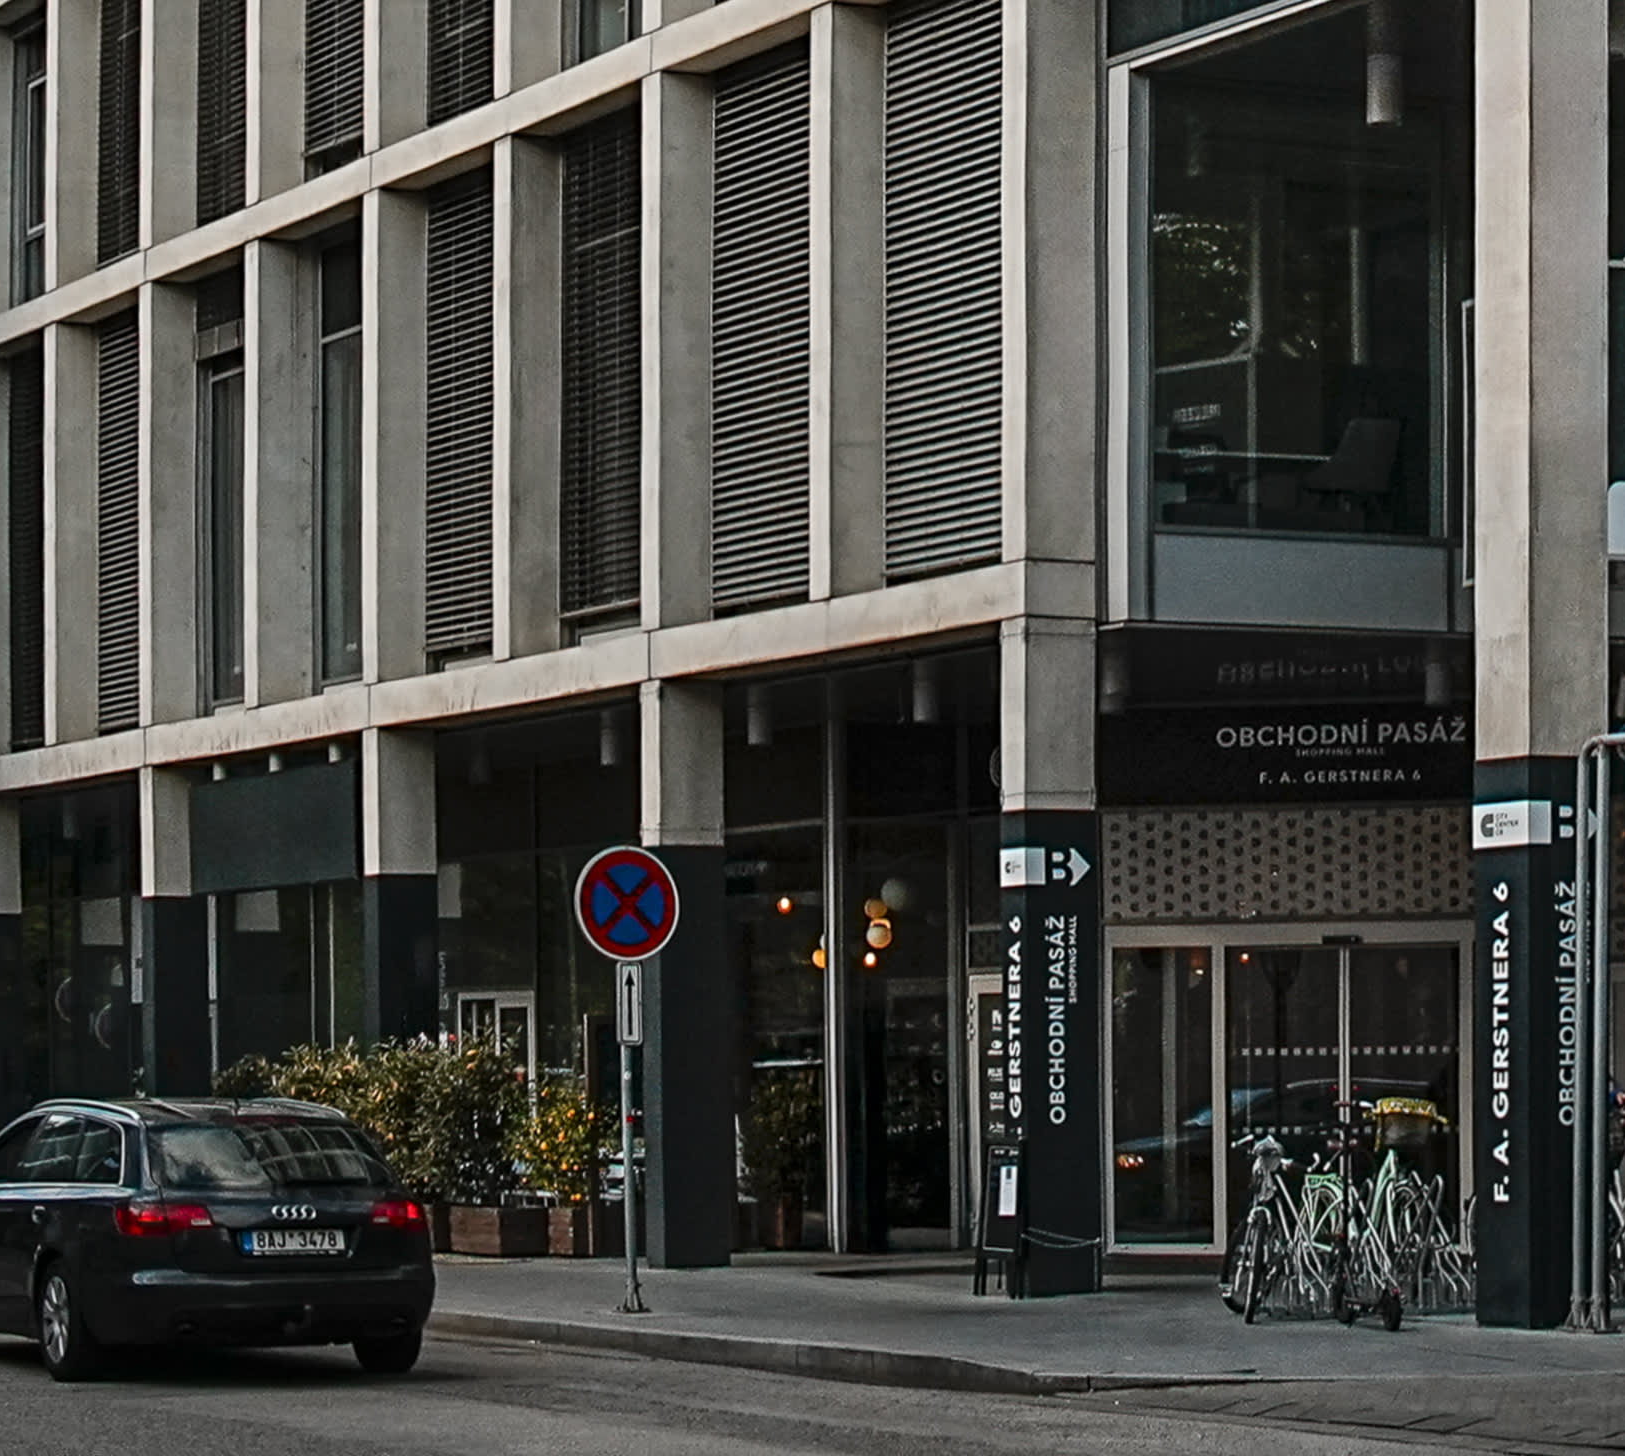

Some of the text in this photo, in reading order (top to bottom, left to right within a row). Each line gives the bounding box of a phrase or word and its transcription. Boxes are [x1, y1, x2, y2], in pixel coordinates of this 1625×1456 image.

[1215, 715, 1467, 748] OBCHODNÍ PASÁŽ
[1295, 747, 1385, 757] SHOPPING MALL
[1259, 769, 1422, 784] F. A. GERSTNERA 6
[1069, 915, 1077, 1004] SHOPPING MALL
[1554, 881, 1576, 1127] OBCHODNÍ PASÁŽ
[1008, 915, 1022, 1118] GERSTNERA 6
[1044, 915, 1066, 1125] OBCHODNÍ PASÁŽ
[1492, 881, 1510, 1203] F. A. GERSTNERA 6
[256, 1231, 338, 1248] 8AJ 3478
